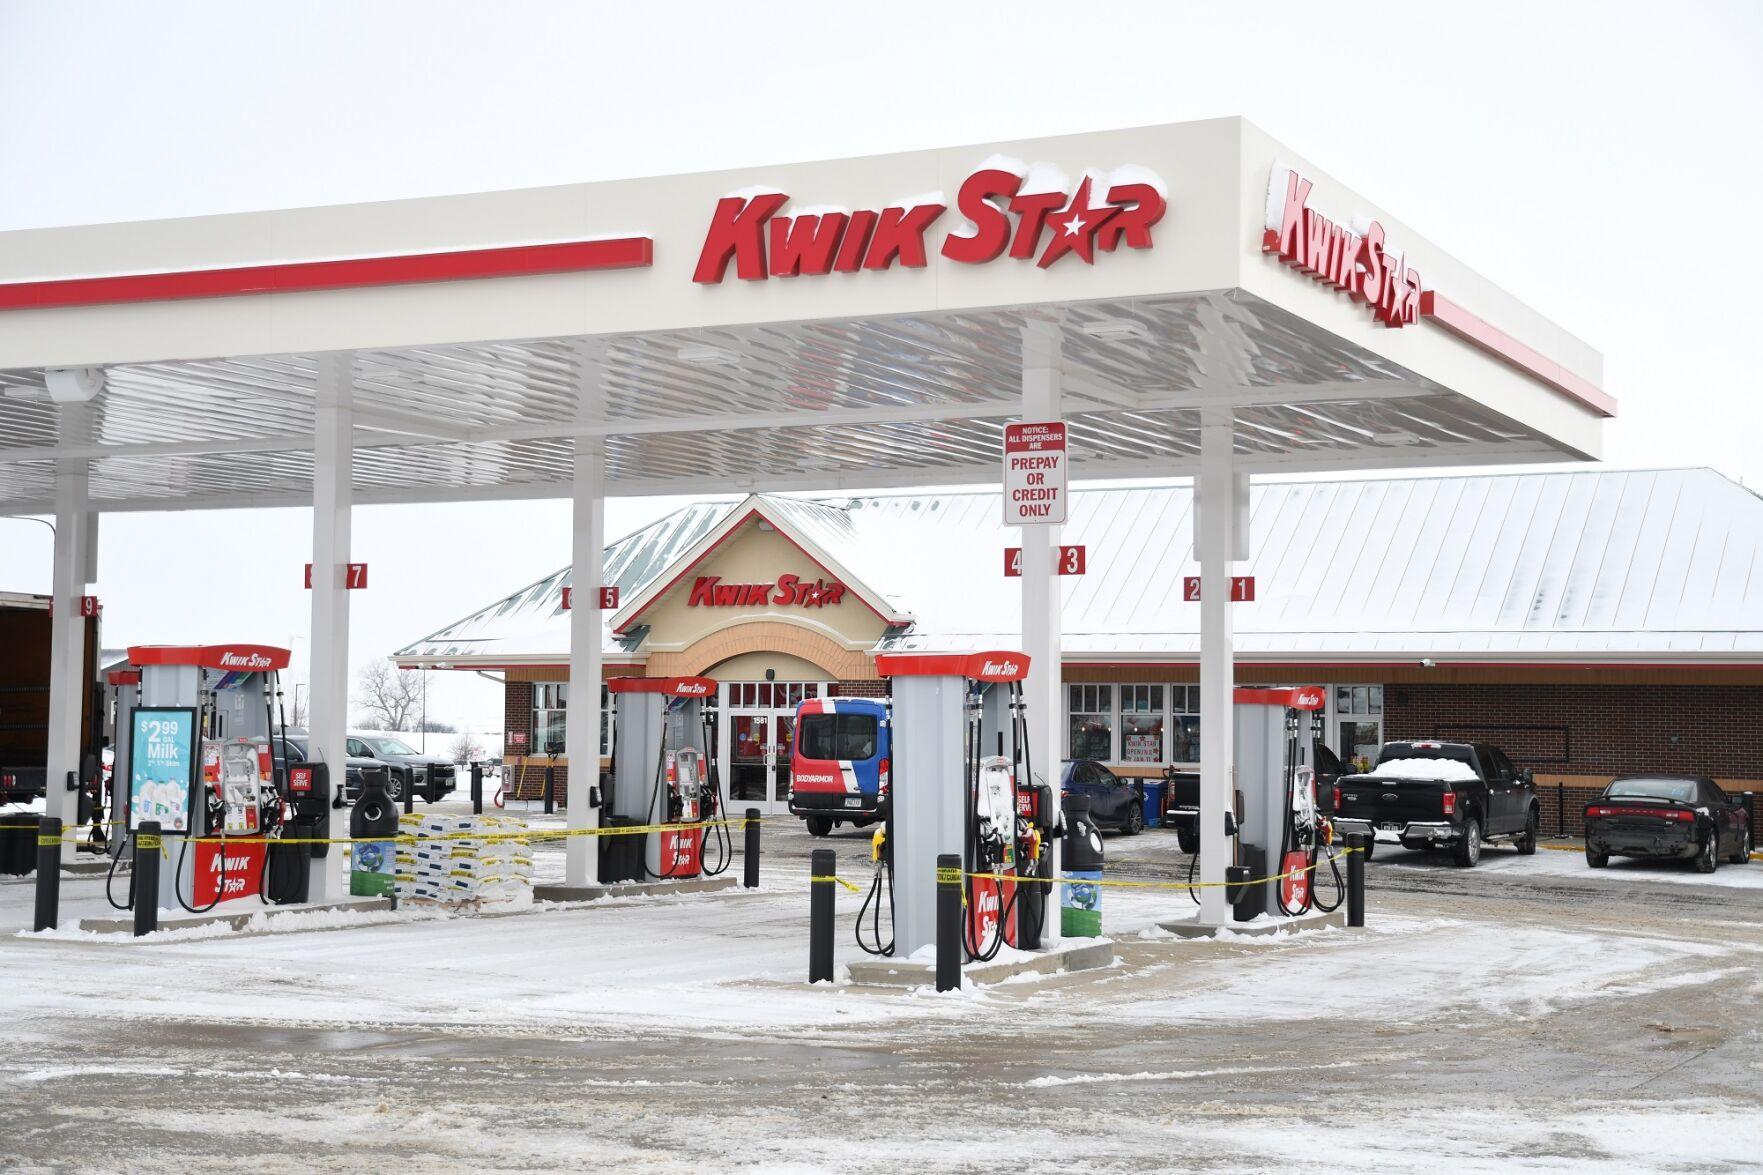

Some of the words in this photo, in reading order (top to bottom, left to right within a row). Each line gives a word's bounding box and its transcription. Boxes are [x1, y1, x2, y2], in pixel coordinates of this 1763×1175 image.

[1008, 434, 1021, 443] ALL
[1022, 433, 1063, 443] DISPENSERS
[1022, 426, 1048, 435] NOTICE:
[1029, 442, 1042, 450] ARE
[1011, 456, 1059, 470] PREPAY
[1026, 472, 1044, 485] OR
[1012, 487, 1058, 502] CREDIT
[1019, 503, 1051, 517] ONLY
[1011, 550, 1022, 575] 4
[1066, 547, 1078, 574] 3
[352, 565, 362, 587] 7
[1189, 578, 1200, 600] 2
[1238, 578, 1246, 600] 1
[605, 588, 614, 608] 5
[85, 597, 93, 615] 9
[753, 716, 768, 725] 1581
[147, 743, 178, 759] Milk
[796, 774, 834, 783] BODYARMOR
